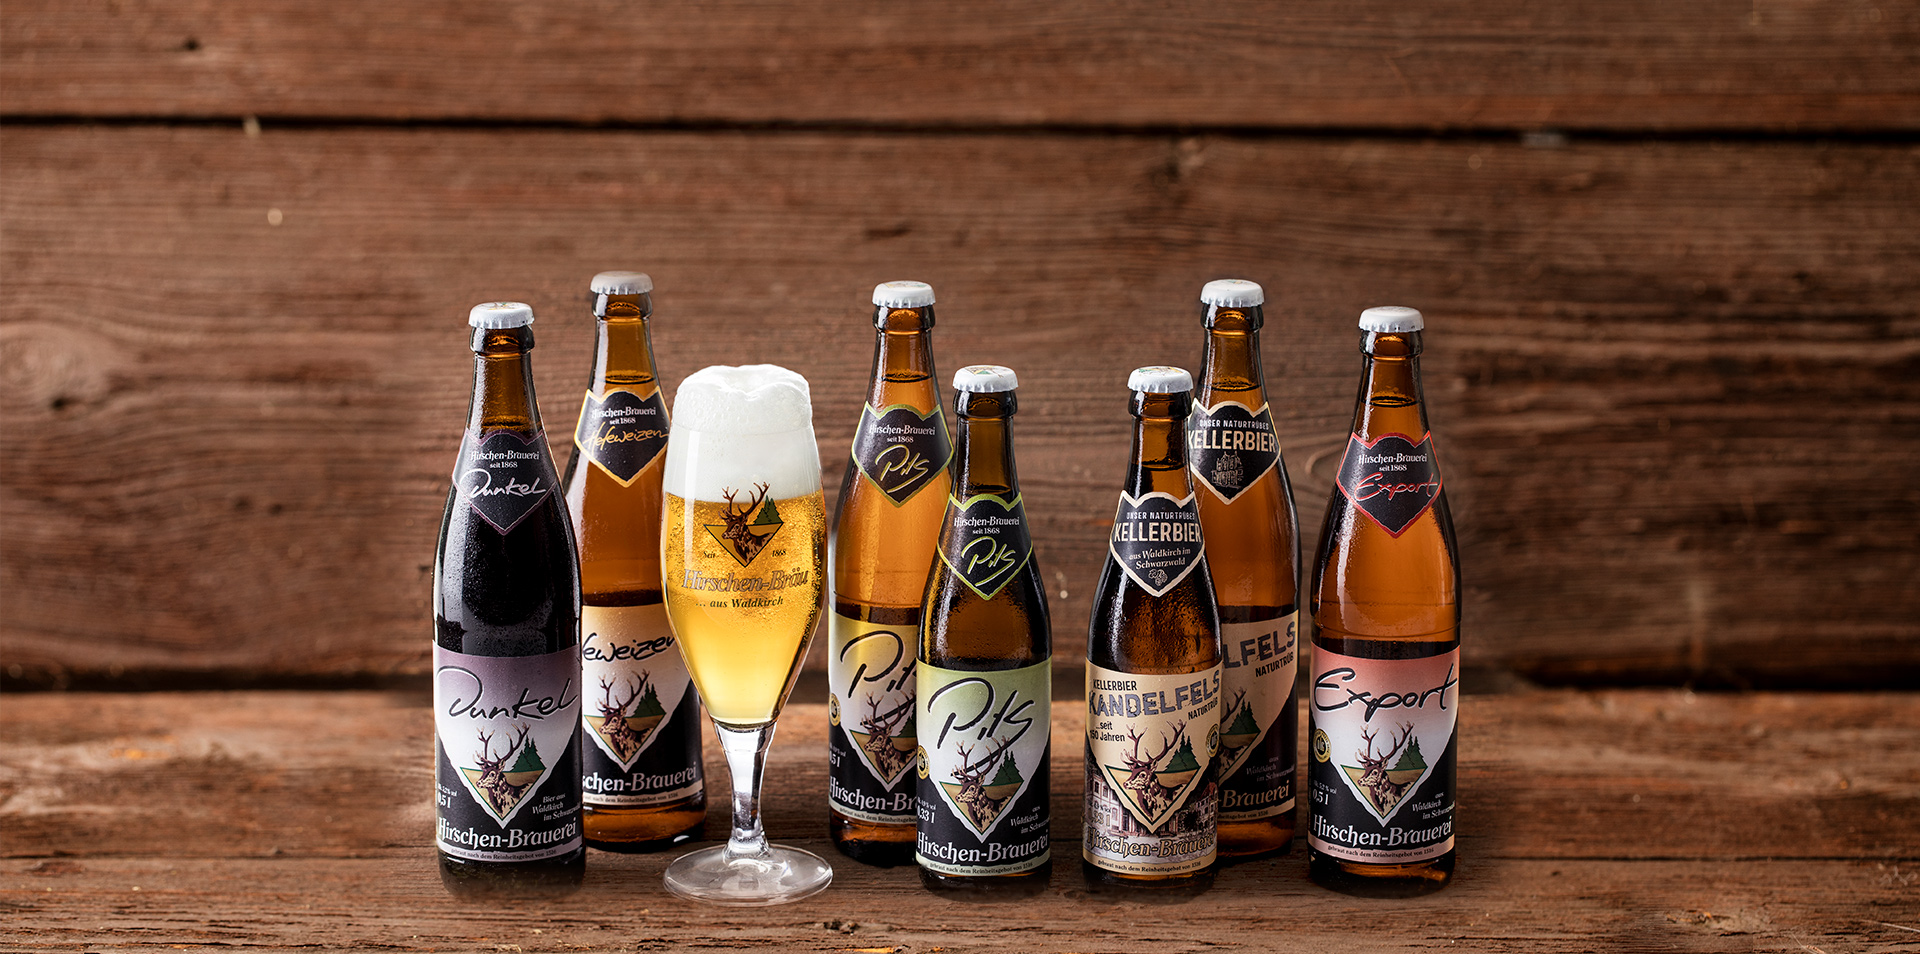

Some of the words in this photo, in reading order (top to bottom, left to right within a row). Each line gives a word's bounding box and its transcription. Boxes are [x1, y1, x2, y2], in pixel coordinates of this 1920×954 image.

[592, 407, 656, 418] Hirschen-Brauerei
[620, 417, 636, 425] 1868
[583, 422, 669, 455] Hefeweizen
[869, 424, 936, 436] Hirschen-Brauerei
[1188, 430, 1276, 453] KELLERBIER
[470, 450, 540, 462] Hirschen-Brauerei
[501, 461, 518, 469] 1868
[1358, 452, 1428, 465] Hirschen-Brauerei
[875, 444, 930, 494] Pils
[460, 468, 547, 499] Dunkel
[1353, 472, 1438, 502] Export
[953, 515, 1020, 528] Hirschen-Brauerei
[1114, 521, 1202, 543] KELLERBIER
[703, 551, 716, 559] Seit
[771, 549, 787, 558] 1868
[961, 535, 1016, 587] Pils
[1128, 552, 1141, 561] aus
[1142, 548, 1181, 559] Waldkirch
[1182, 547, 1191, 555] im
[1135, 557, 1186, 570] Schwarzwald
[681, 566, 809, 593] Hirschen-Bräu
[710, 600, 728, 608] aus
[731, 596, 784, 608] Waldkirch
[1222, 621, 1296, 669] LFELS
[840, 630, 916, 726] Pil
[1093, 679, 1138, 691] KELLERBIER
[437, 665, 579, 720] Dunkel
[1088, 670, 1220, 718] KANDELFELS
[1314, 663, 1458, 723] Export
[928, 677, 1035, 776] Pils
[1100, 731, 1126, 742] Jahren
[582, 761, 697, 794] schen-Brauerei
[543, 795, 555, 803] Bier
[829, 775, 917, 812] Hirschen-Br
[532, 801, 564, 815] Waldkirch
[1412, 800, 1442, 812] Waldkirch
[1422, 812, 1430, 820] im
[1010, 812, 1039, 827] Waldkirch
[438, 816, 577, 850] Hirschen-Brauerei
[1313, 814, 1452, 848] Hirschen-Brauerei
[917, 829, 1048, 864] Hirschen-Brauerei
